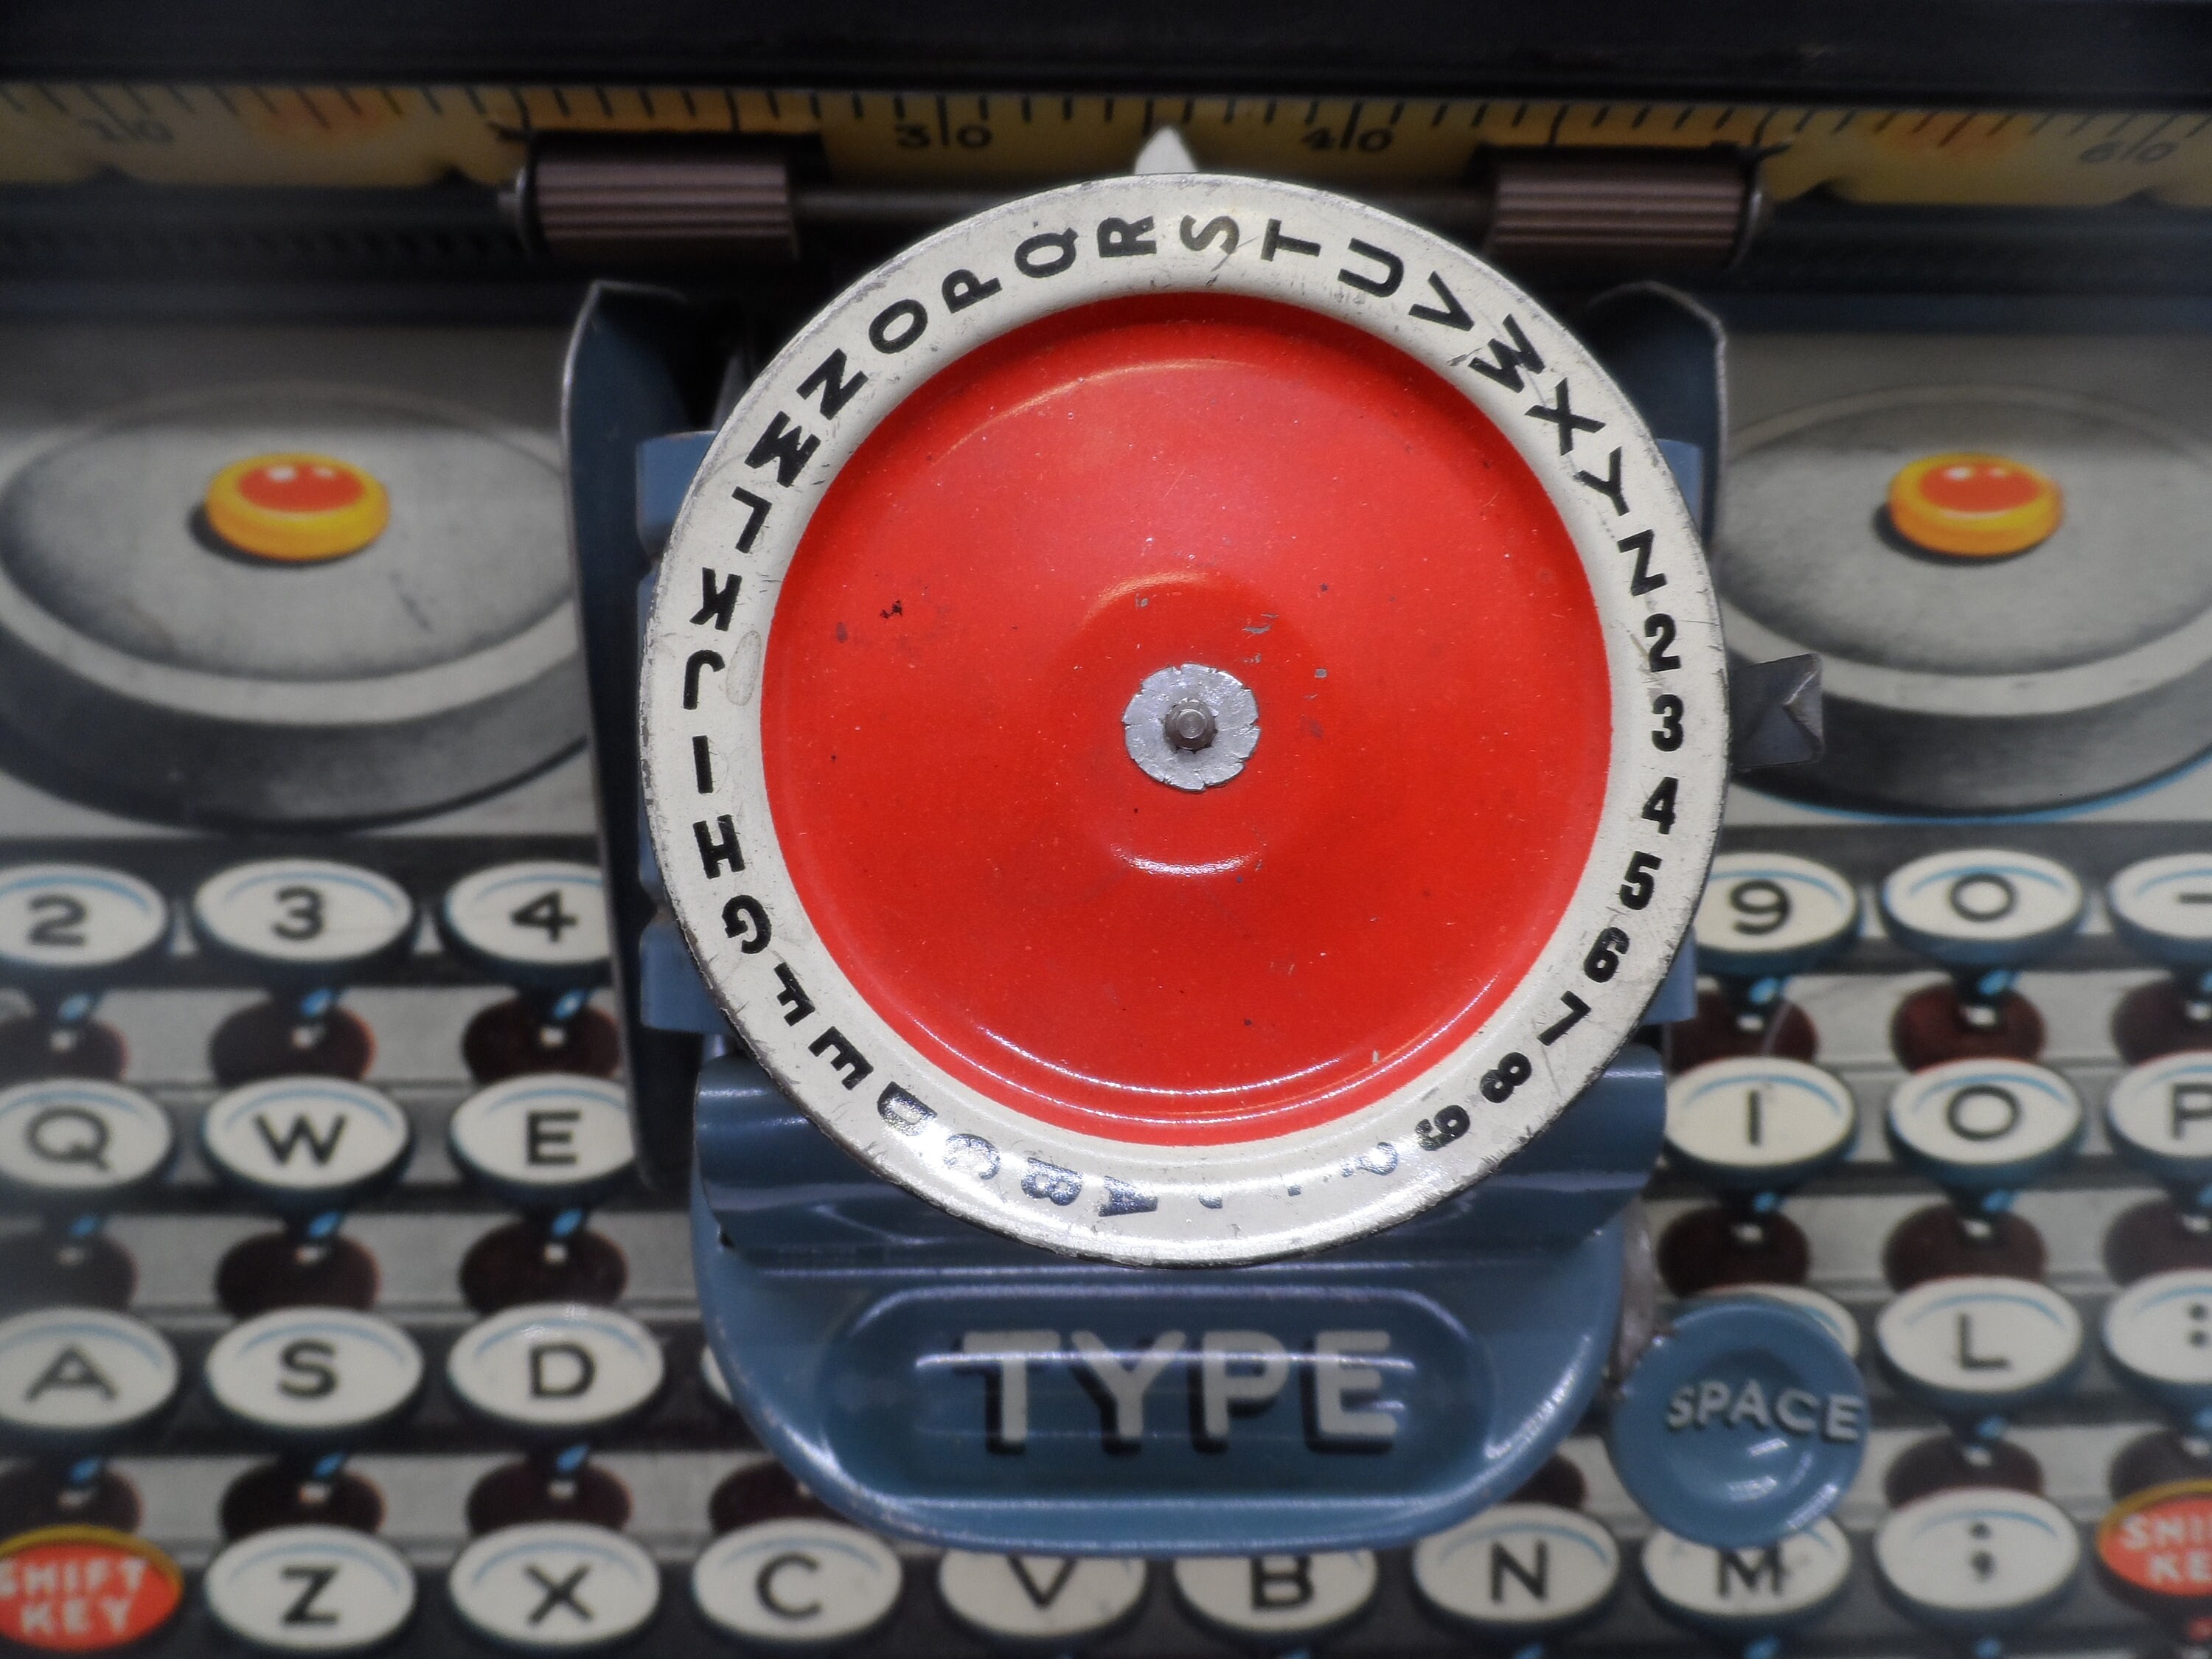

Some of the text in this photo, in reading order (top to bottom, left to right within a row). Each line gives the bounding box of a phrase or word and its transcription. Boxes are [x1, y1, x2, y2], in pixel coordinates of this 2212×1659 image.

[1015, 228, 1078, 278] Q
[1097, 217, 1156, 257] R
[1180, 215, 1239, 255] S
[1262, 219, 1321, 261] T
[942, 270, 1001, 313] P
[1338, 238, 1404, 297] U
[869, 299, 928, 354] O
[1409, 271, 1474, 331] V
[1469, 314, 1545, 393] W
[797, 349, 868, 420] N
[1526, 378, 1605, 456] X
[745, 411, 820, 487] M
[1574, 448, 1629, 516] Y
[732, 487, 771, 553] L
[1618, 529, 1666, 596] Z
[690, 568, 742, 631] K
[1645, 613, 1680, 672] 2
[684, 650, 725, 709] J
[1652, 695, 1683, 751] 3
[692, 736, 713, 793] I
[1642, 777, 1678, 834] 4
[693, 815, 745, 879] H
[1618, 852, 1662, 910] 5
[1729, 874, 1792, 936] 9
[27, 894, 87, 947] 2
[272, 886, 325, 942] 3
[510, 891, 577, 943] 4
[722, 895, 771, 954] G
[1584, 928, 1630, 983] 6
[774, 962, 815, 1026] F
[1538, 991, 1591, 1046] 7
[809, 1026, 873, 1090] E
[1481, 1052, 1532, 1103] 8
[877, 1081, 938, 1136] D
[1416, 1105, 1470, 1151] 9
[1947, 1085, 2021, 1142] O
[2170, 1082, 2212, 1139] P
[25, 1107, 111, 1171] Q
[253, 1115, 346, 1166] W
[526, 1110, 580, 1166] E
[1021, 1157, 1082, 1206] B
[1098, 1175, 1158, 1217] A
[279, 1339, 338, 1401] S
[528, 1342, 597, 1400] D
[1953, 1313, 2011, 1373] L
[24, 1343, 118, 1403] A
[958, 1329, 1399, 1447] TYPE
[1667, 1377, 1861, 1441] SPACE
[2121, 1514, 2212, 1550] SHI
[281, 1566, 338, 1628] Z
[524, 1565, 593, 1627] X
[754, 1550, 822, 1623] C
[1006, 1556, 1074, 1609] V
[1242, 1554, 1314, 1612] B
[1489, 1540, 1549, 1603] N
[1717, 1548, 1783, 1597] M
[21, 1598, 131, 1635] KEY
